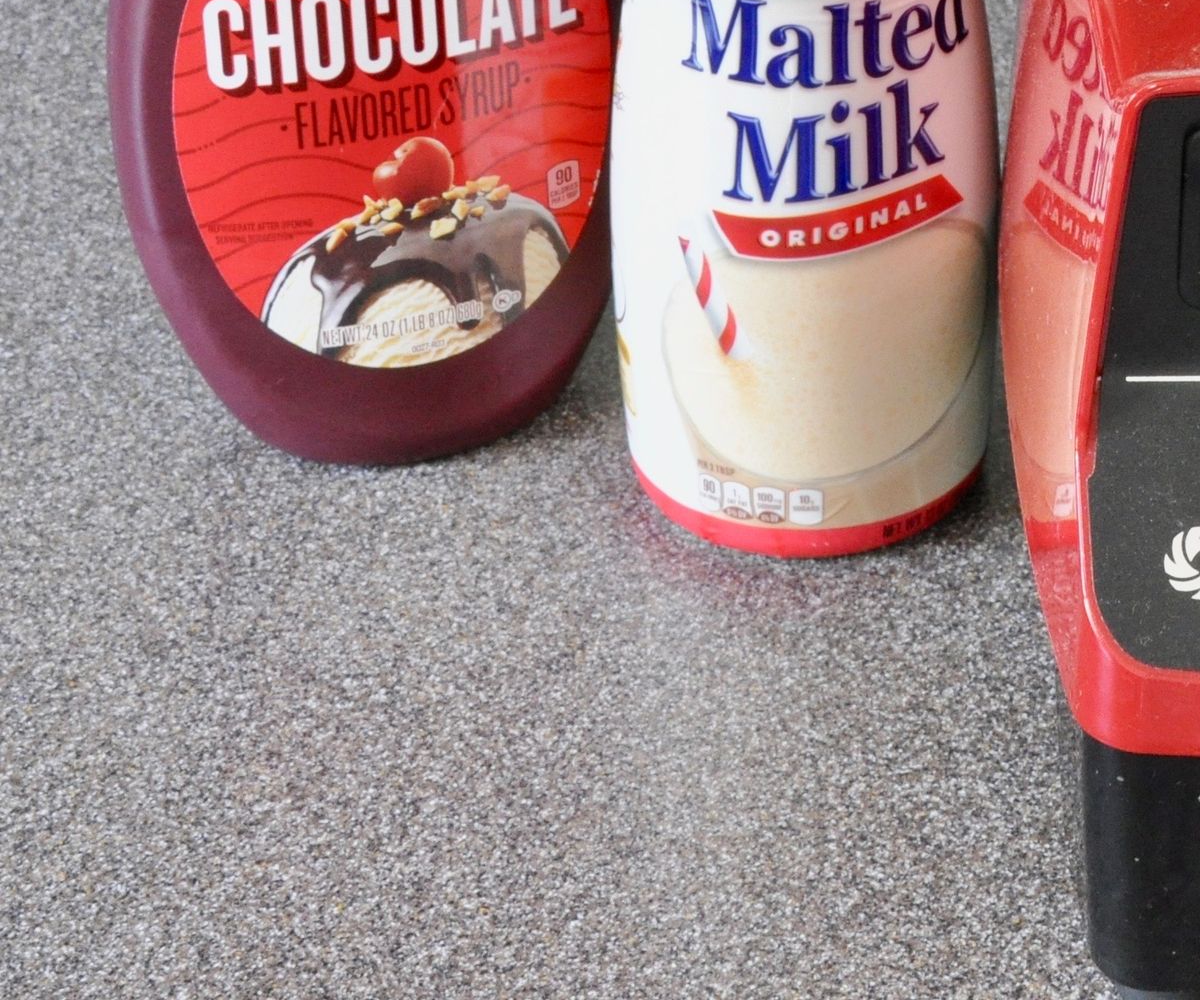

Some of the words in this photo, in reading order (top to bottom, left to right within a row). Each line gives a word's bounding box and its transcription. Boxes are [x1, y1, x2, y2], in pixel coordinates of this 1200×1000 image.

[294, 82, 432, 150] FLAVORED
[438, 60, 521, 128] SYRUP
[722, 78, 946, 205] Milk
[756, 193, 928, 249] ORIGINAL
[366, 323, 378, 341] 24
[382, 320, 395, 338] OZ
[412, 314, 425, 332] LB
